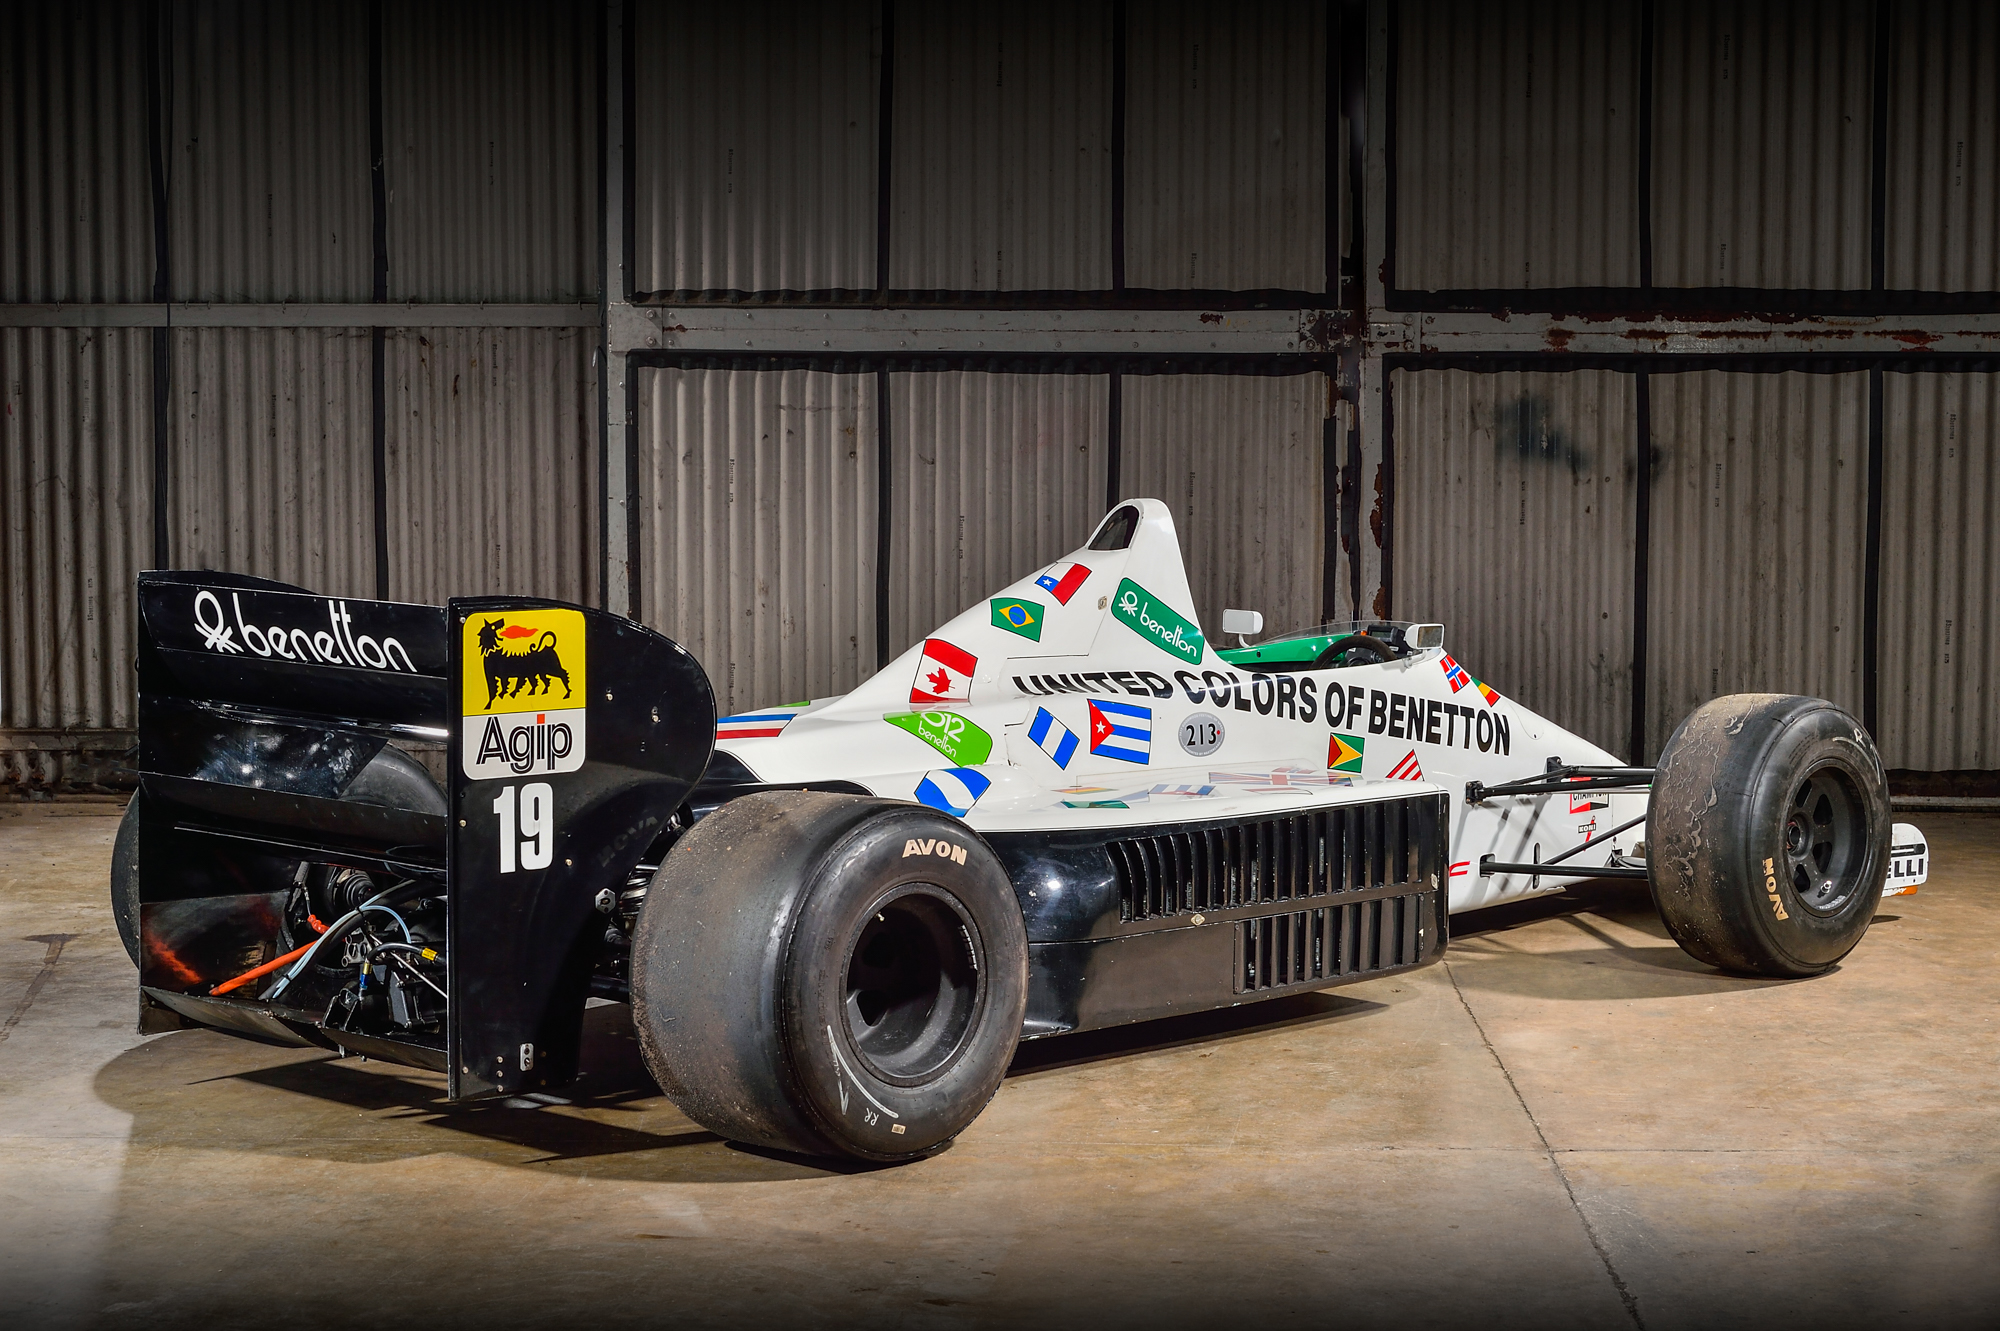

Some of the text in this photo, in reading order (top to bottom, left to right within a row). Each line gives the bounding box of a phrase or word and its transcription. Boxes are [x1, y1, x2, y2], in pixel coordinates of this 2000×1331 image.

[233, 592, 418, 672] benetton
[1140, 602, 1197, 657] benetton
[918, 720, 957, 758] benetton
[920, 711, 966, 744] 012
[1012, 670, 1511, 757] UNITED COLORS OF BENETTON
[1186, 723, 1217, 747] 213
[476, 714, 573, 775] Agip
[493, 783, 554, 874] 19
[902, 838, 969, 866] AVON
[1579, 824, 1596, 832] KONI
[1762, 857, 1789, 921] AVON
